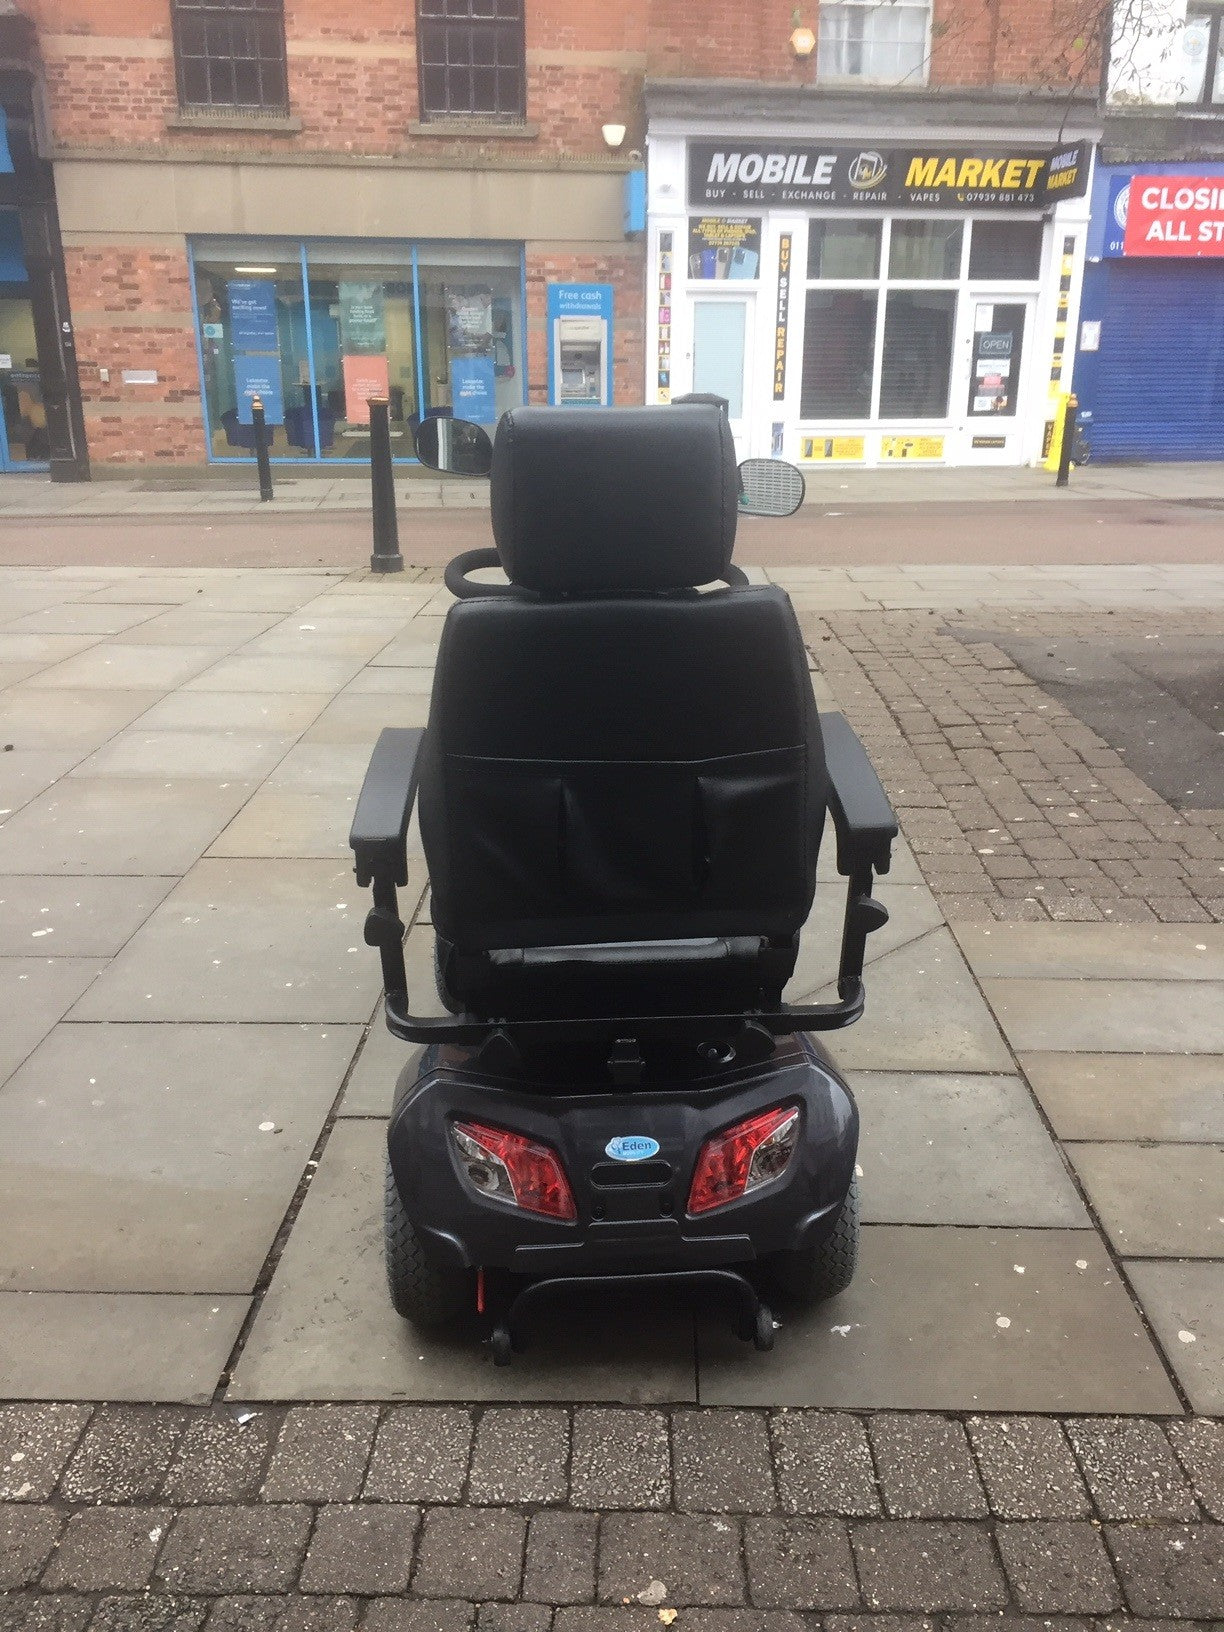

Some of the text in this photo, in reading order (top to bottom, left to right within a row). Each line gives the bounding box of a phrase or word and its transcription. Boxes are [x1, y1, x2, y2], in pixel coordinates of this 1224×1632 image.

[707, 153, 1045, 189] MOBILE MARKET
[1050, 150, 1079, 171] MOBILE
[1047, 169, 1077, 190] MARKET
[705, 189, 726, 198] BUY
[743, 190, 765, 199] SELL
[782, 190, 837, 200] EXCHANGE
[853, 191, 887, 201] REPAIR
[910, 192, 940, 202] VAPES
[966, 192, 996, 202] 07939
[1145, 220, 1192, 241] ALL
[780, 238, 790, 272] BUY
[559, 289, 601, 299] Free cash
[778, 277, 788, 322] SELL
[983, 340, 1010, 350] OPEN
[775, 326, 786, 393] REPAIR
[622, 1141, 652, 1151] Eden
